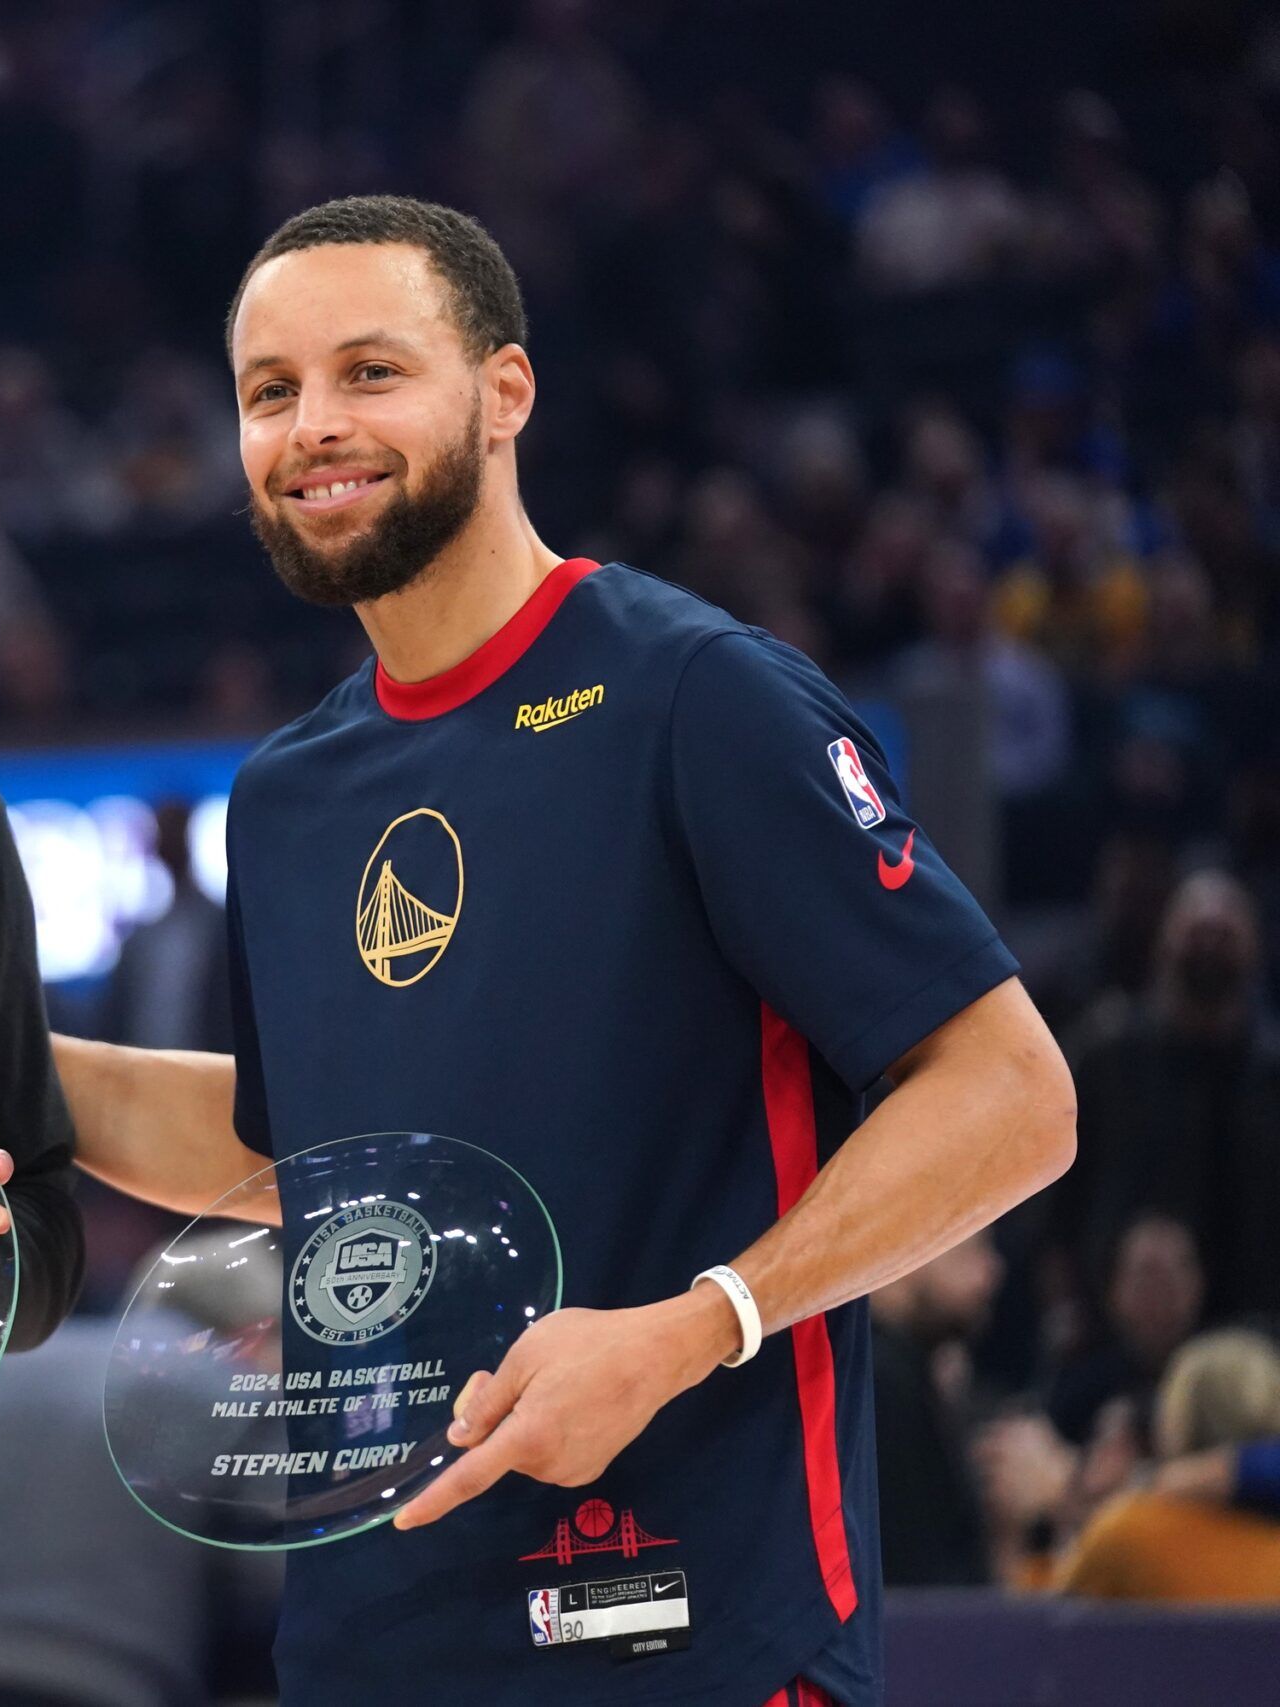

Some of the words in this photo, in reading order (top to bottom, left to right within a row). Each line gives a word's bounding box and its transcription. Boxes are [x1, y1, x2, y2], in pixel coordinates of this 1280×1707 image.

[515, 684, 604, 730] Rakuten
[312, 1221, 340, 1248] USA
[343, 1204, 427, 1240] BASKETBALL
[339, 1241, 393, 1270] USA
[319, 1327, 346, 1342] EST.
[352, 1323, 385, 1341] 1974
[229, 1373, 281, 1392] 2024
[285, 1371, 322, 1391] USA
[328, 1359, 446, 1388] BASKETBALL
[211, 1401, 262, 1418] MALE
[264, 1397, 341, 1417] ATHLETE
[343, 1395, 364, 1413] OF
[371, 1391, 403, 1410] THE
[407, 1385, 451, 1405] YEAR
[210, 1450, 330, 1477] STEPHEN
[332, 1440, 419, 1472] CURRY
[569, 1593, 578, 1605] L
[590, 1581, 647, 1596] ENGINEERED
[563, 1620, 584, 1641] 30
[632, 1641, 646, 1653] CITY
[646, 1639, 668, 1651] EDITION
